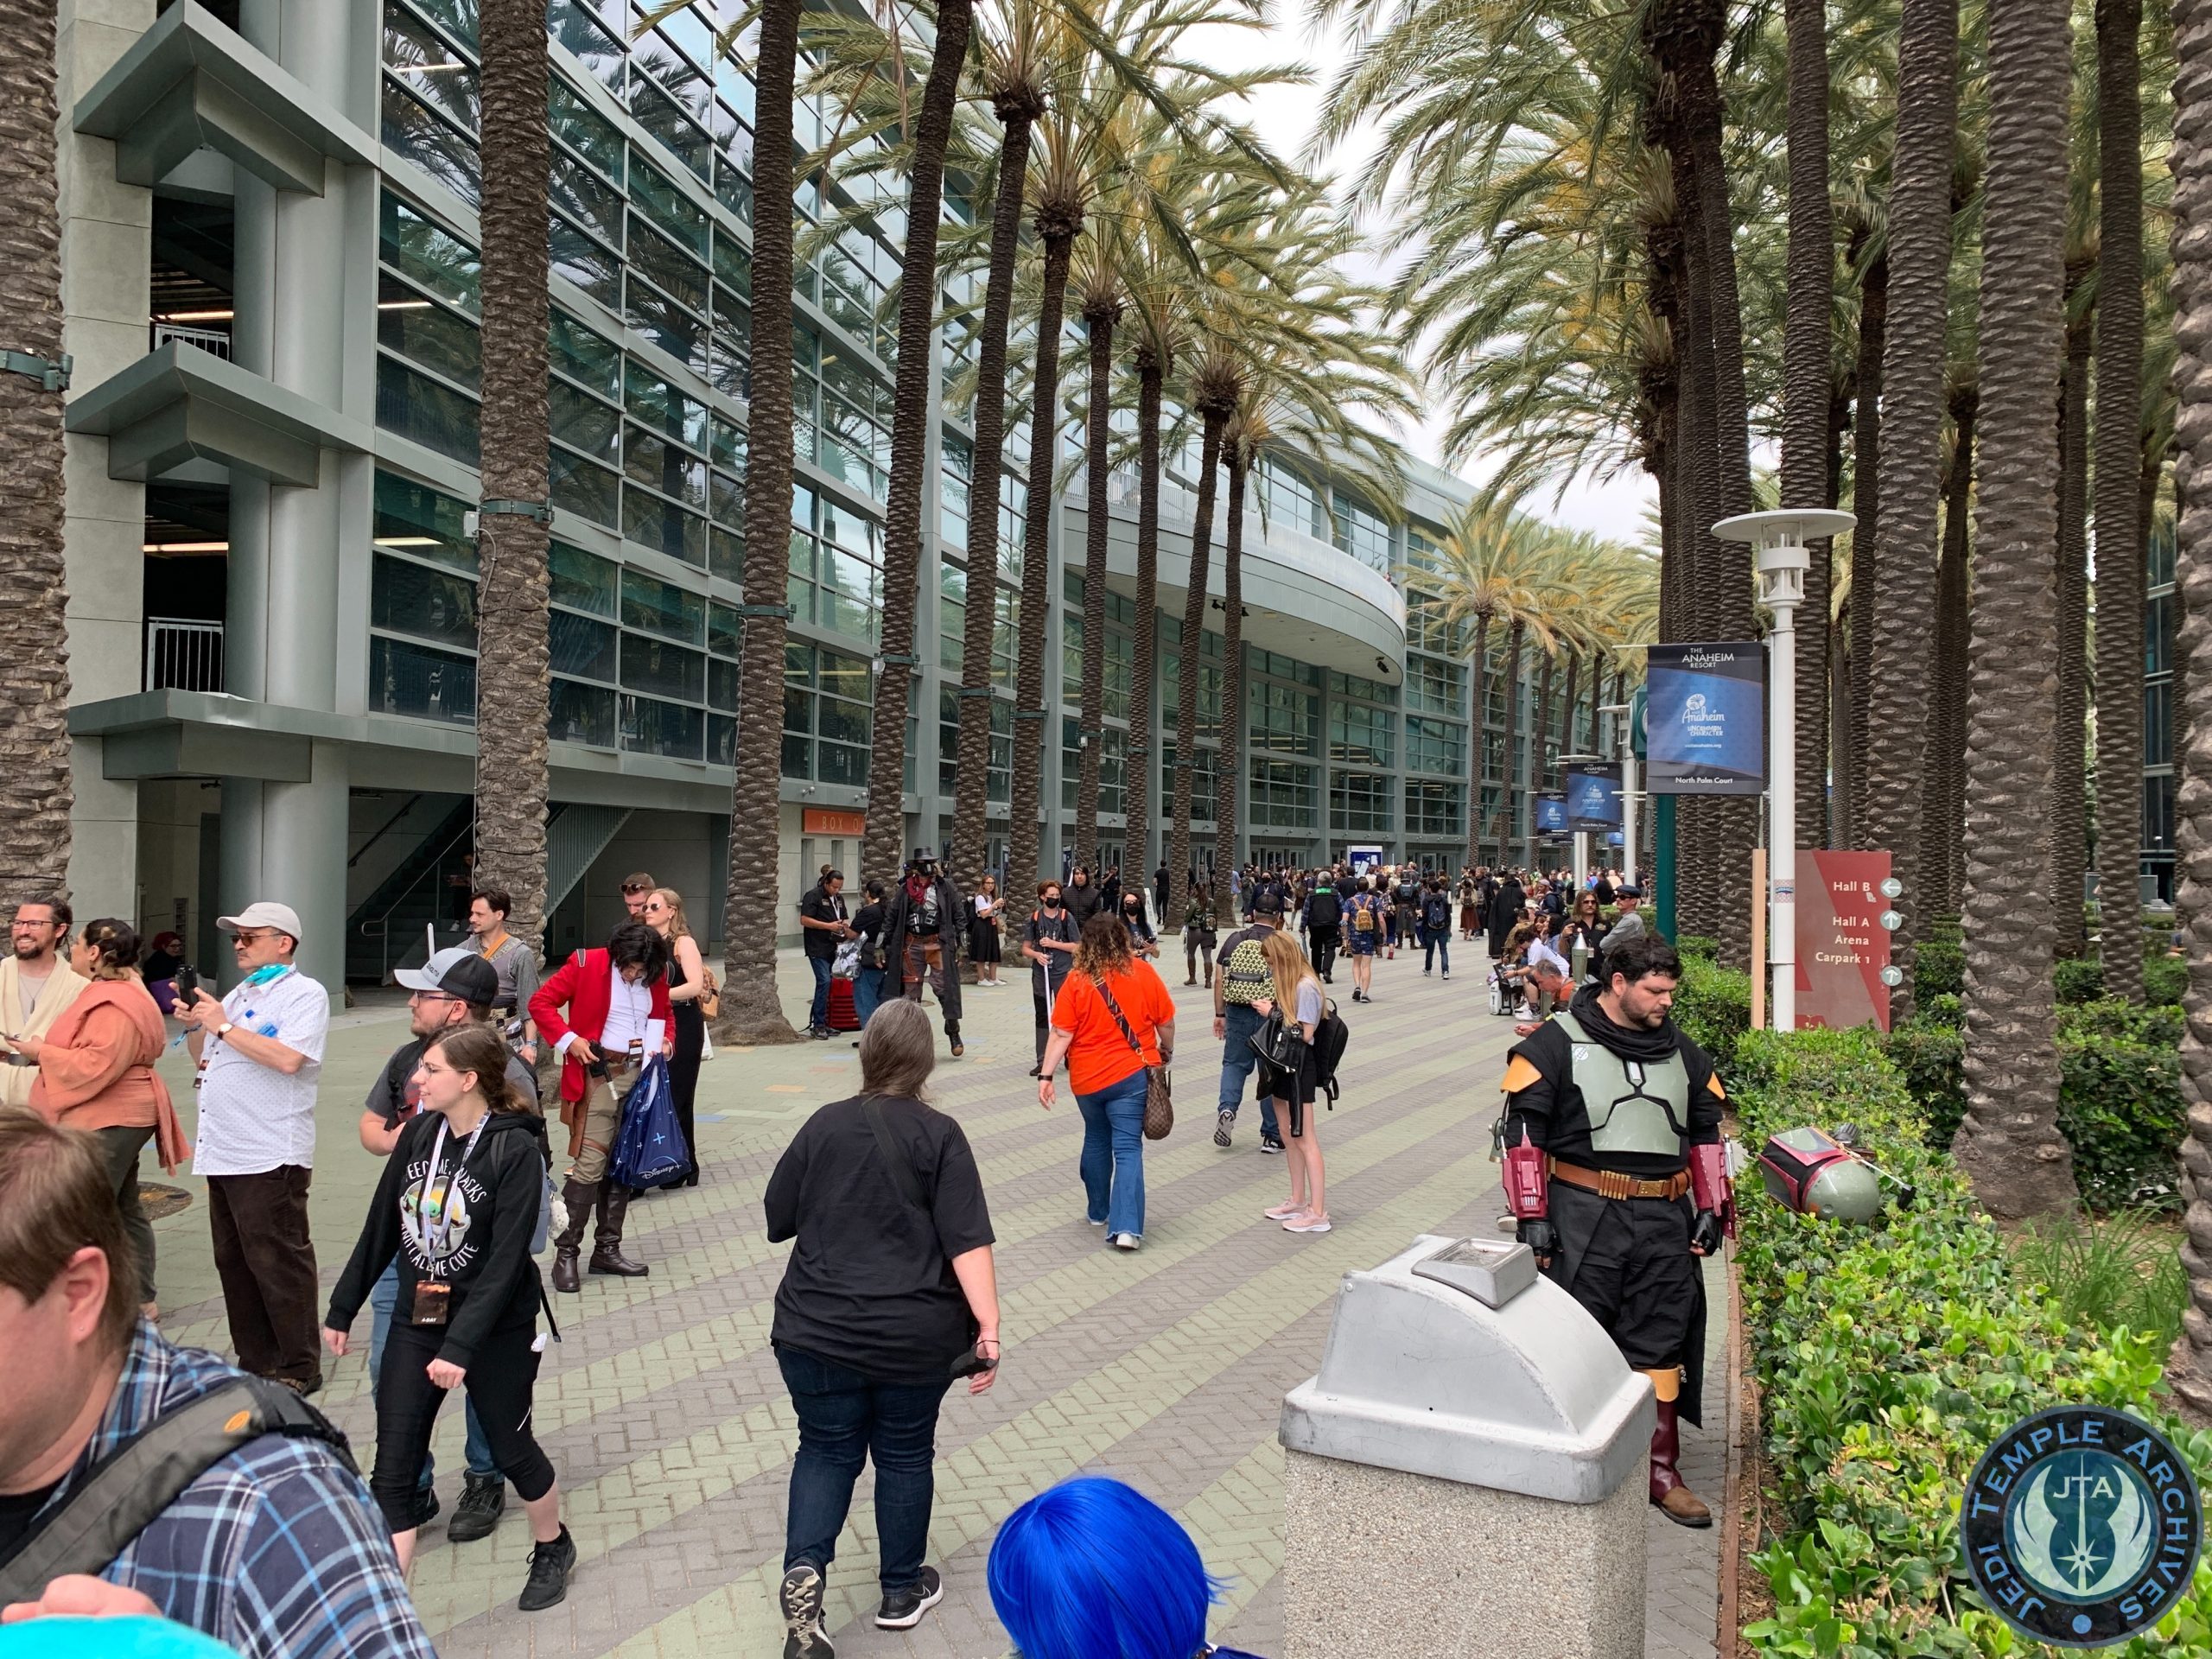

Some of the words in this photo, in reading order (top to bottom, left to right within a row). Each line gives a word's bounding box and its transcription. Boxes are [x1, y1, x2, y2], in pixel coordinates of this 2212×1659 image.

[1682, 652, 1734, 663] ANAHEIM
[1681, 707, 1725, 723] Anaheim
[822, 816, 842, 830] BOX
[1834, 881, 1857, 892] Hall
[1862, 882, 1871, 892] B
[1833, 916, 1856, 926] Hall
[1861, 918, 1870, 927] A
[1834, 935, 1869, 945] Arena
[1815, 952, 1860, 964] Carpark
[1865, 956, 1871, 964] 1
[406, 1160, 429, 1183] EED
[448, 1163, 487, 1204] NACKS
[449, 1243, 480, 1272] CUTE
